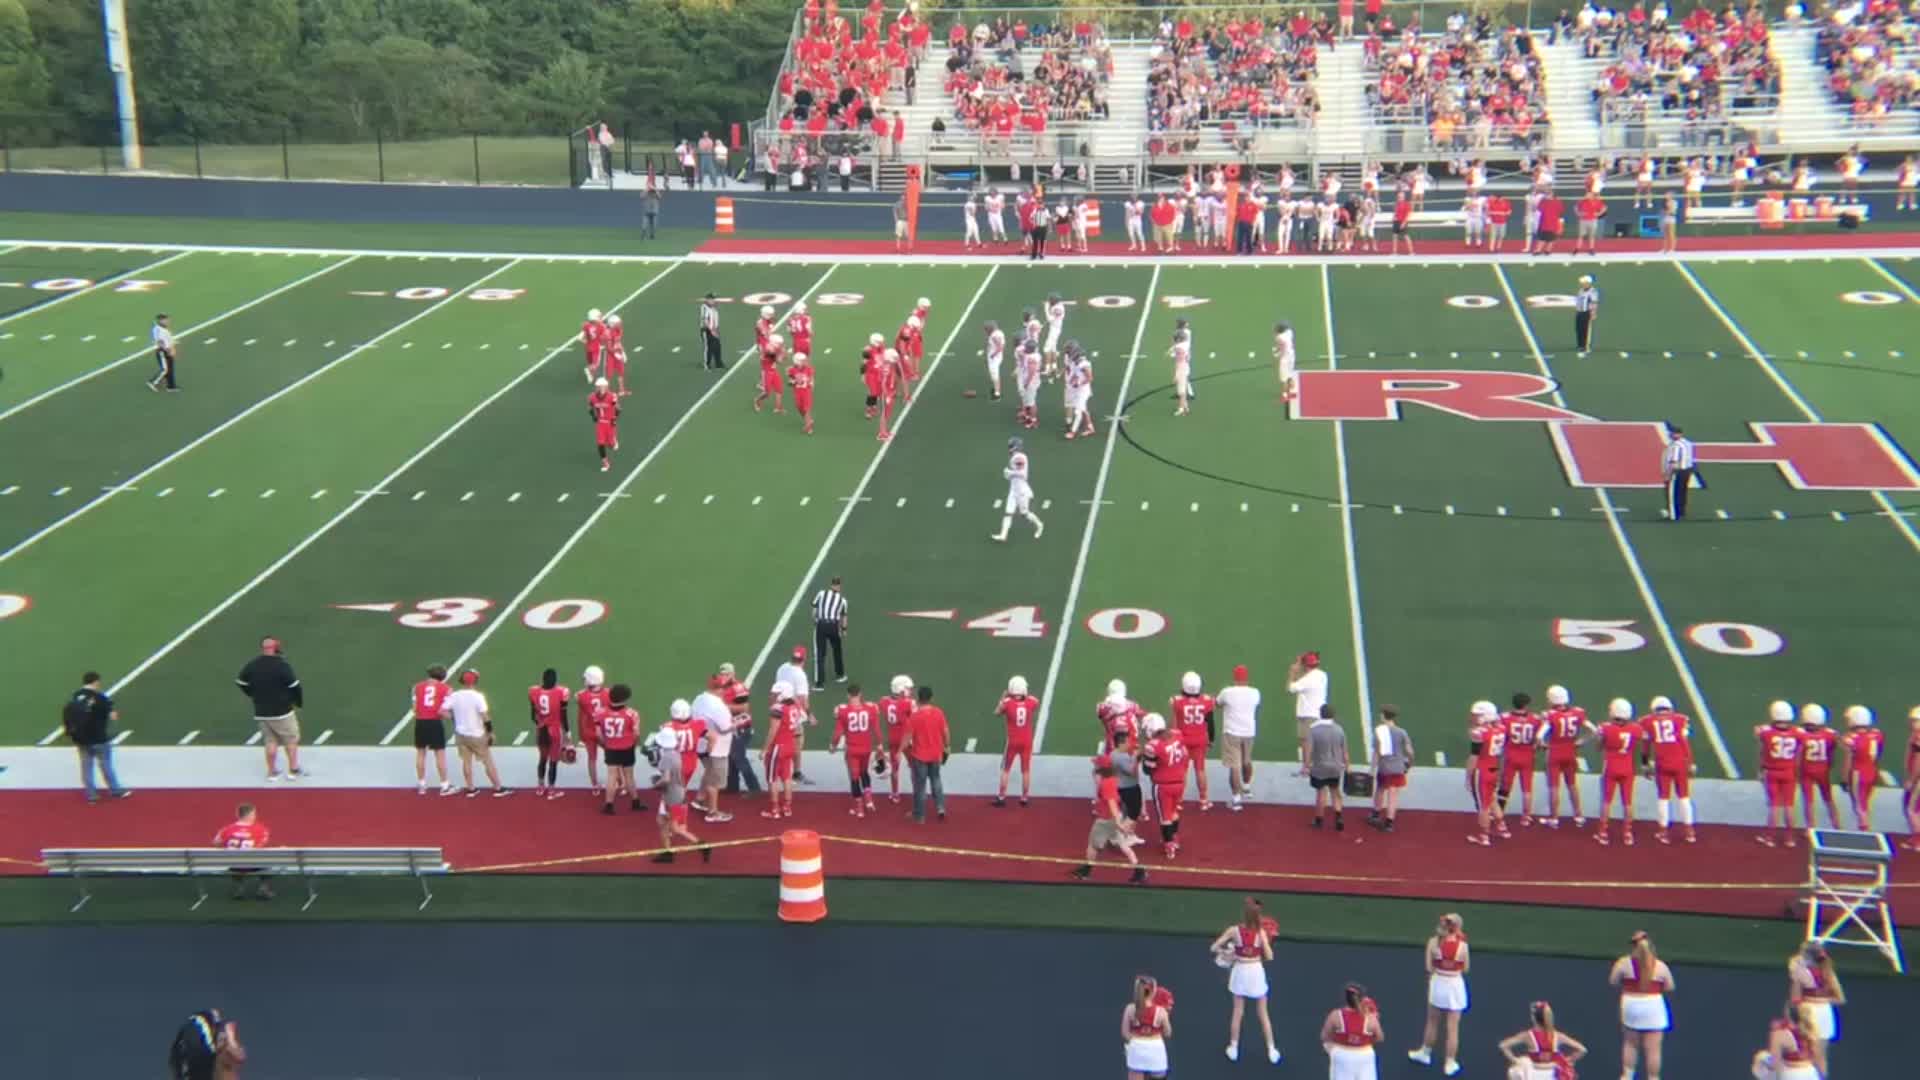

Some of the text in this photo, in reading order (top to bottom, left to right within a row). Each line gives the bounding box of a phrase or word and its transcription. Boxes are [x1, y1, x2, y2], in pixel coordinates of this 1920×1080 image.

[423, 685, 437, 707] 2
[539, 694, 550, 716] 9
[847, 711, 869, 733] 20
[887, 703, 898, 725] 6
[1016, 706, 1027, 727] 8
[1184, 704, 1205, 726] 55
[604, 717, 625, 739] 57
[1510, 721, 1534, 745] 50
[1559, 716, 1579, 738] 15
[1652, 719, 1677, 743] 12
[676, 729, 693, 753] 71
[1618, 731, 1632, 754] 7
[1770, 735, 1797, 760] 32
[1805, 738, 1828, 762] 21
